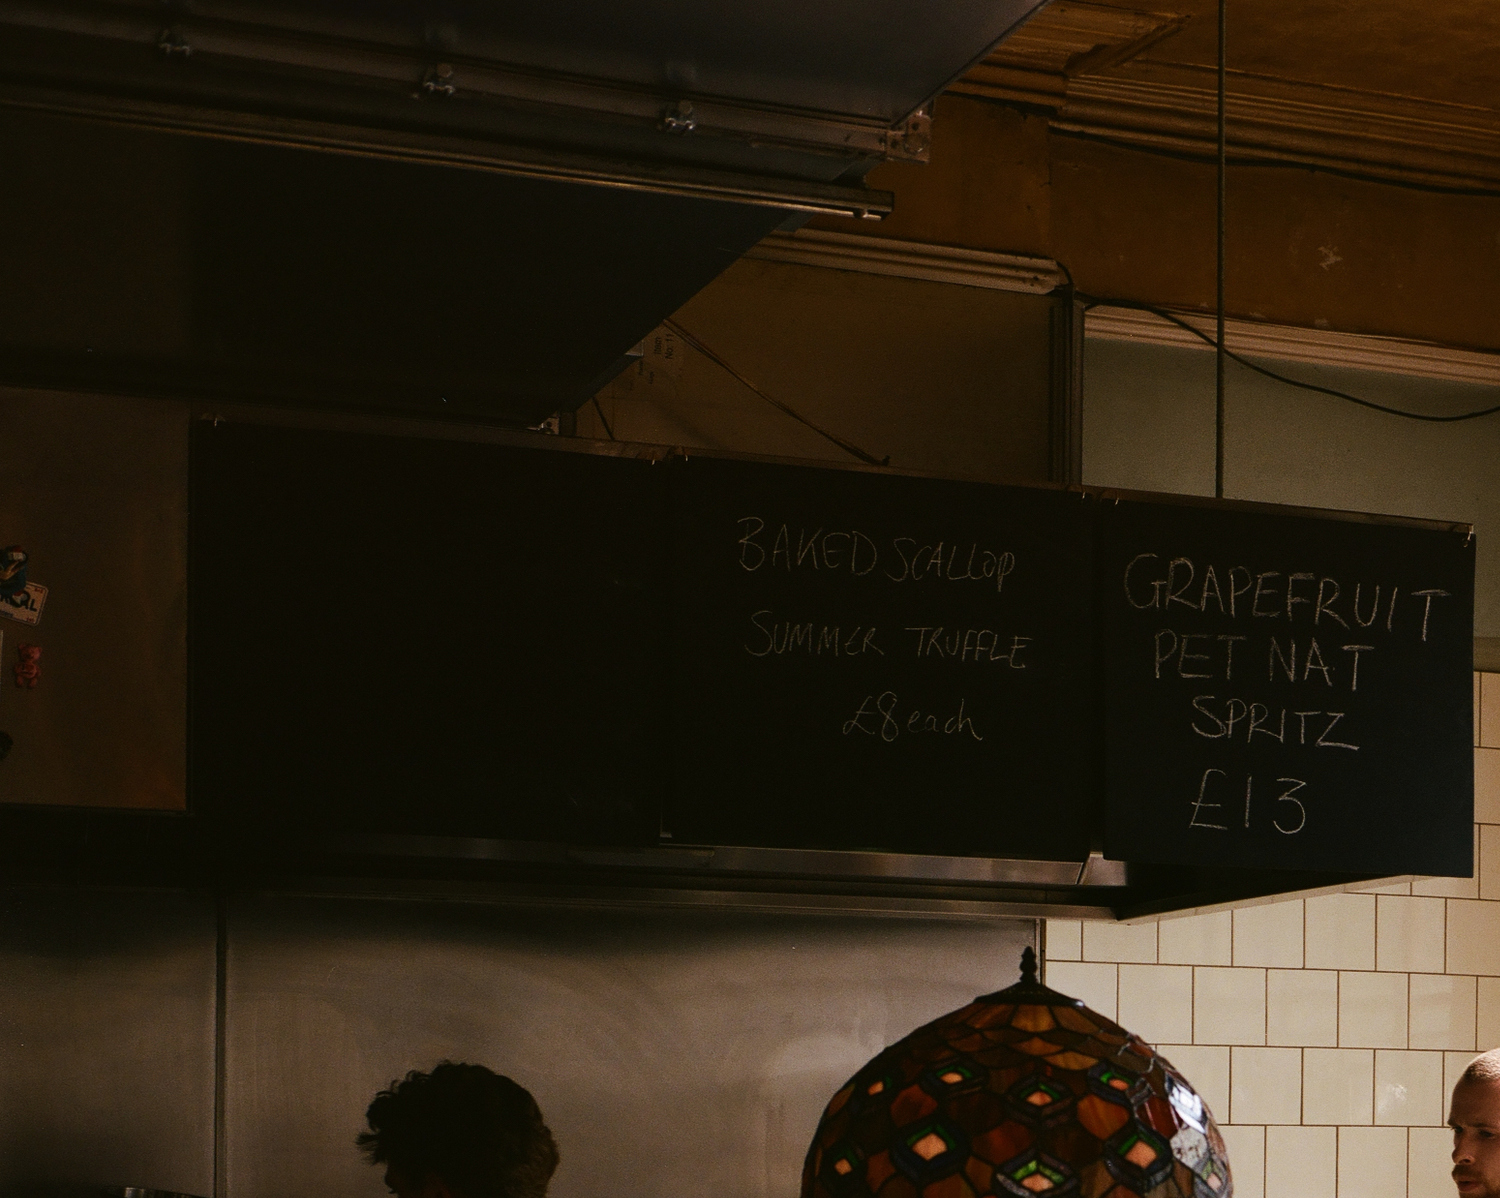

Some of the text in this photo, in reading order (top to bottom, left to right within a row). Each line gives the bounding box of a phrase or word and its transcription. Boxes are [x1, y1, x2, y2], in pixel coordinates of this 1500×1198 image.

[737, 516, 1016, 592] BAKED SCALLOP
[1124, 553, 1452, 642] GRAPEFRUIT
[744, 610, 1032, 669] SUMMER TRUFFLE
[1154, 628, 1374, 692] PET NAT
[842, 691, 983, 742] £8 each
[1191, 695, 1360, 751] SPRITZ
[1189, 768, 1307, 835] £13
